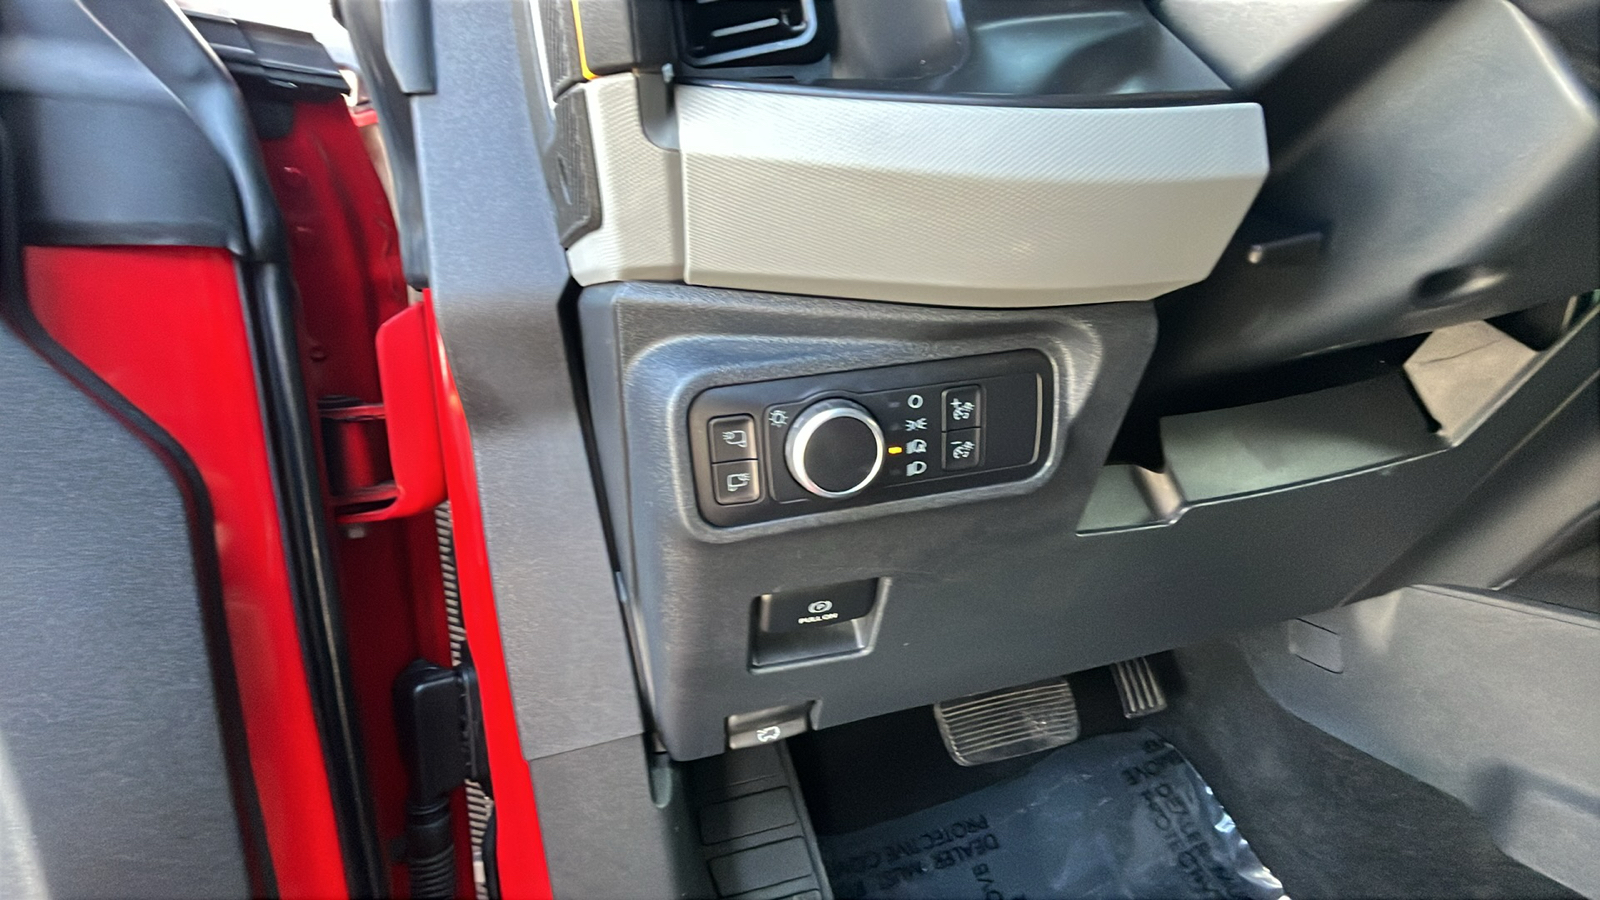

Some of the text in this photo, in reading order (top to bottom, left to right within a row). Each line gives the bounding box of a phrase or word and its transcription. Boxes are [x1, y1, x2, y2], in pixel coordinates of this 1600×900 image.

[798, 616, 822, 625] PULL
[886, 814, 989, 862] PROTECTIVE
[930, 833, 1000, 869] DEALER
